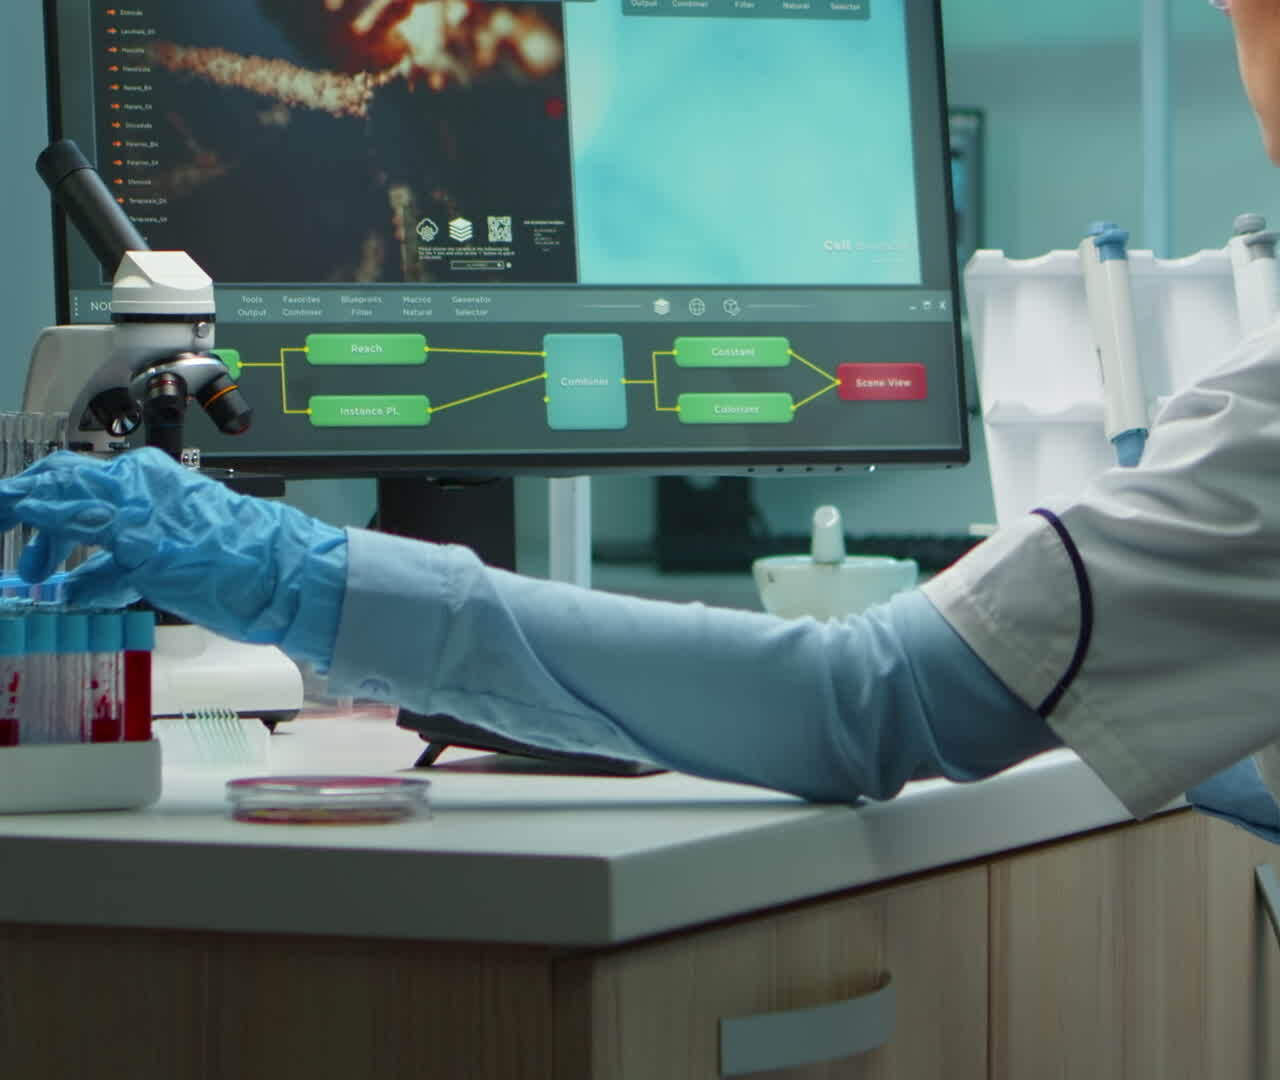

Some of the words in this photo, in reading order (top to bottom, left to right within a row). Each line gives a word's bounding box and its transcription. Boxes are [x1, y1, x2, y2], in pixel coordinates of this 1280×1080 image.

[241, 295, 263, 304] Tools
[237, 308, 267, 318] Output
[711, 347, 756, 357] Constant
[888, 378, 912, 388] View
[340, 407, 383, 417] Instance
